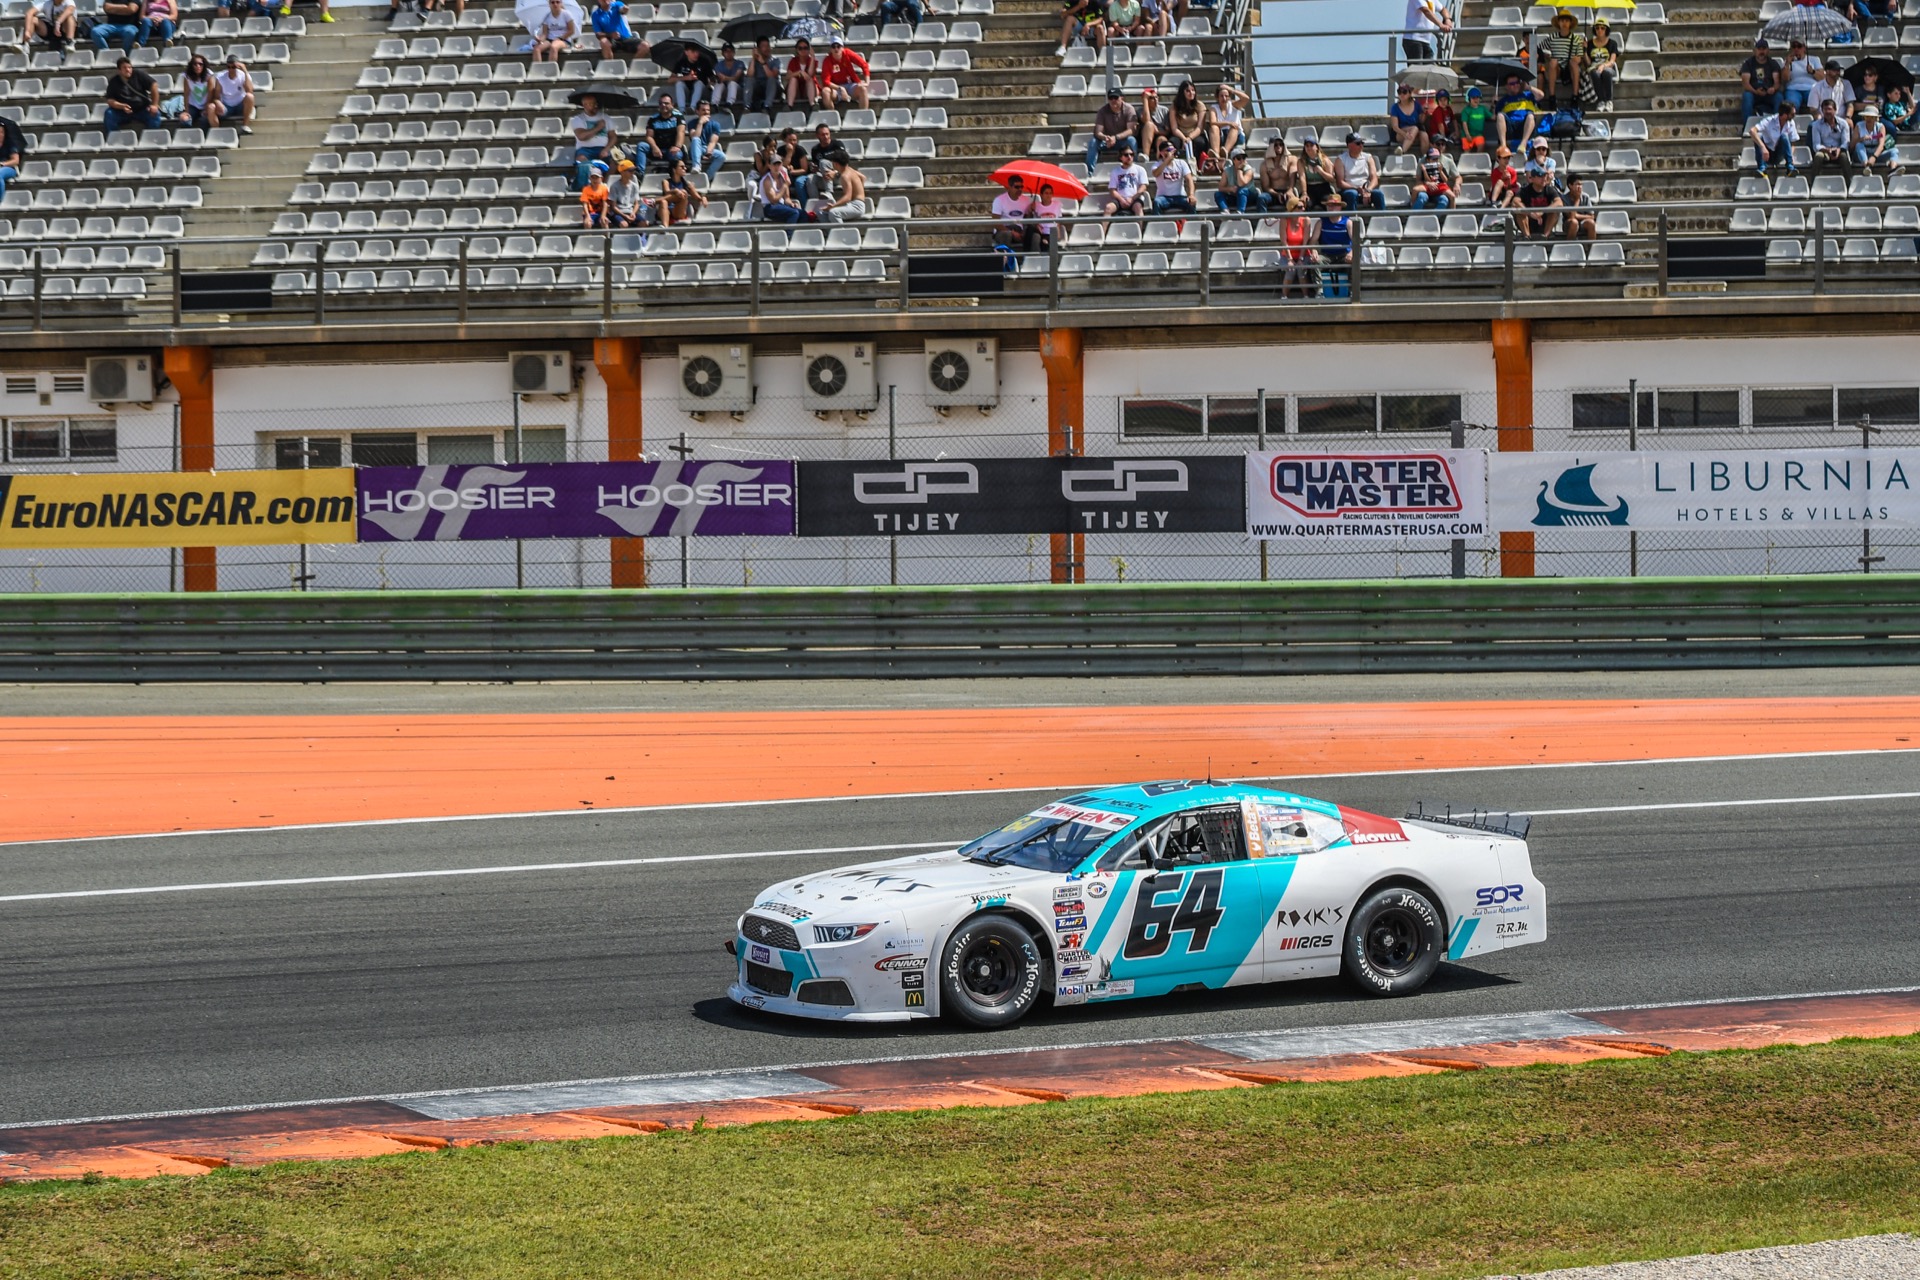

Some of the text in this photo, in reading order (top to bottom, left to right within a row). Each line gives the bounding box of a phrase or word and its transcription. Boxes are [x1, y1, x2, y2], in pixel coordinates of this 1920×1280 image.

[1276, 461, 1442, 496] QUARTER
[1655, 459, 1910, 492] LIBURNIA
[363, 486, 556, 512] HOOSIER
[598, 483, 792, 508] HOOSIER
[1306, 484, 1452, 510] MASTER
[11, 491, 354, 529] EuroNASCAR.com
[874, 513, 960, 531] TIJEY
[1082, 511, 1169, 529] TIJEY
[1397, 512, 1424, 520] DRIVELINE
[1425, 512, 1460, 520] COMPONENTS
[1677, 506, 1889, 521] HOTELS & VILLAS
[1251, 524, 1483, 537] WWW.QUARTERMASTERUSA.COM
[1354, 833, 1406, 844] MOTUL
[1476, 884, 1524, 906] SOR
[1122, 868, 1226, 960] 64
[1397, 894, 1434, 927] Hoosier
[879, 959, 926, 969] KENNOL
[948, 933, 971, 980] Hoosier
[1014, 961, 1039, 1009] Hoosier
[1359, 958, 1394, 991] Hoosier
[1059, 985, 1084, 996] Mobil
